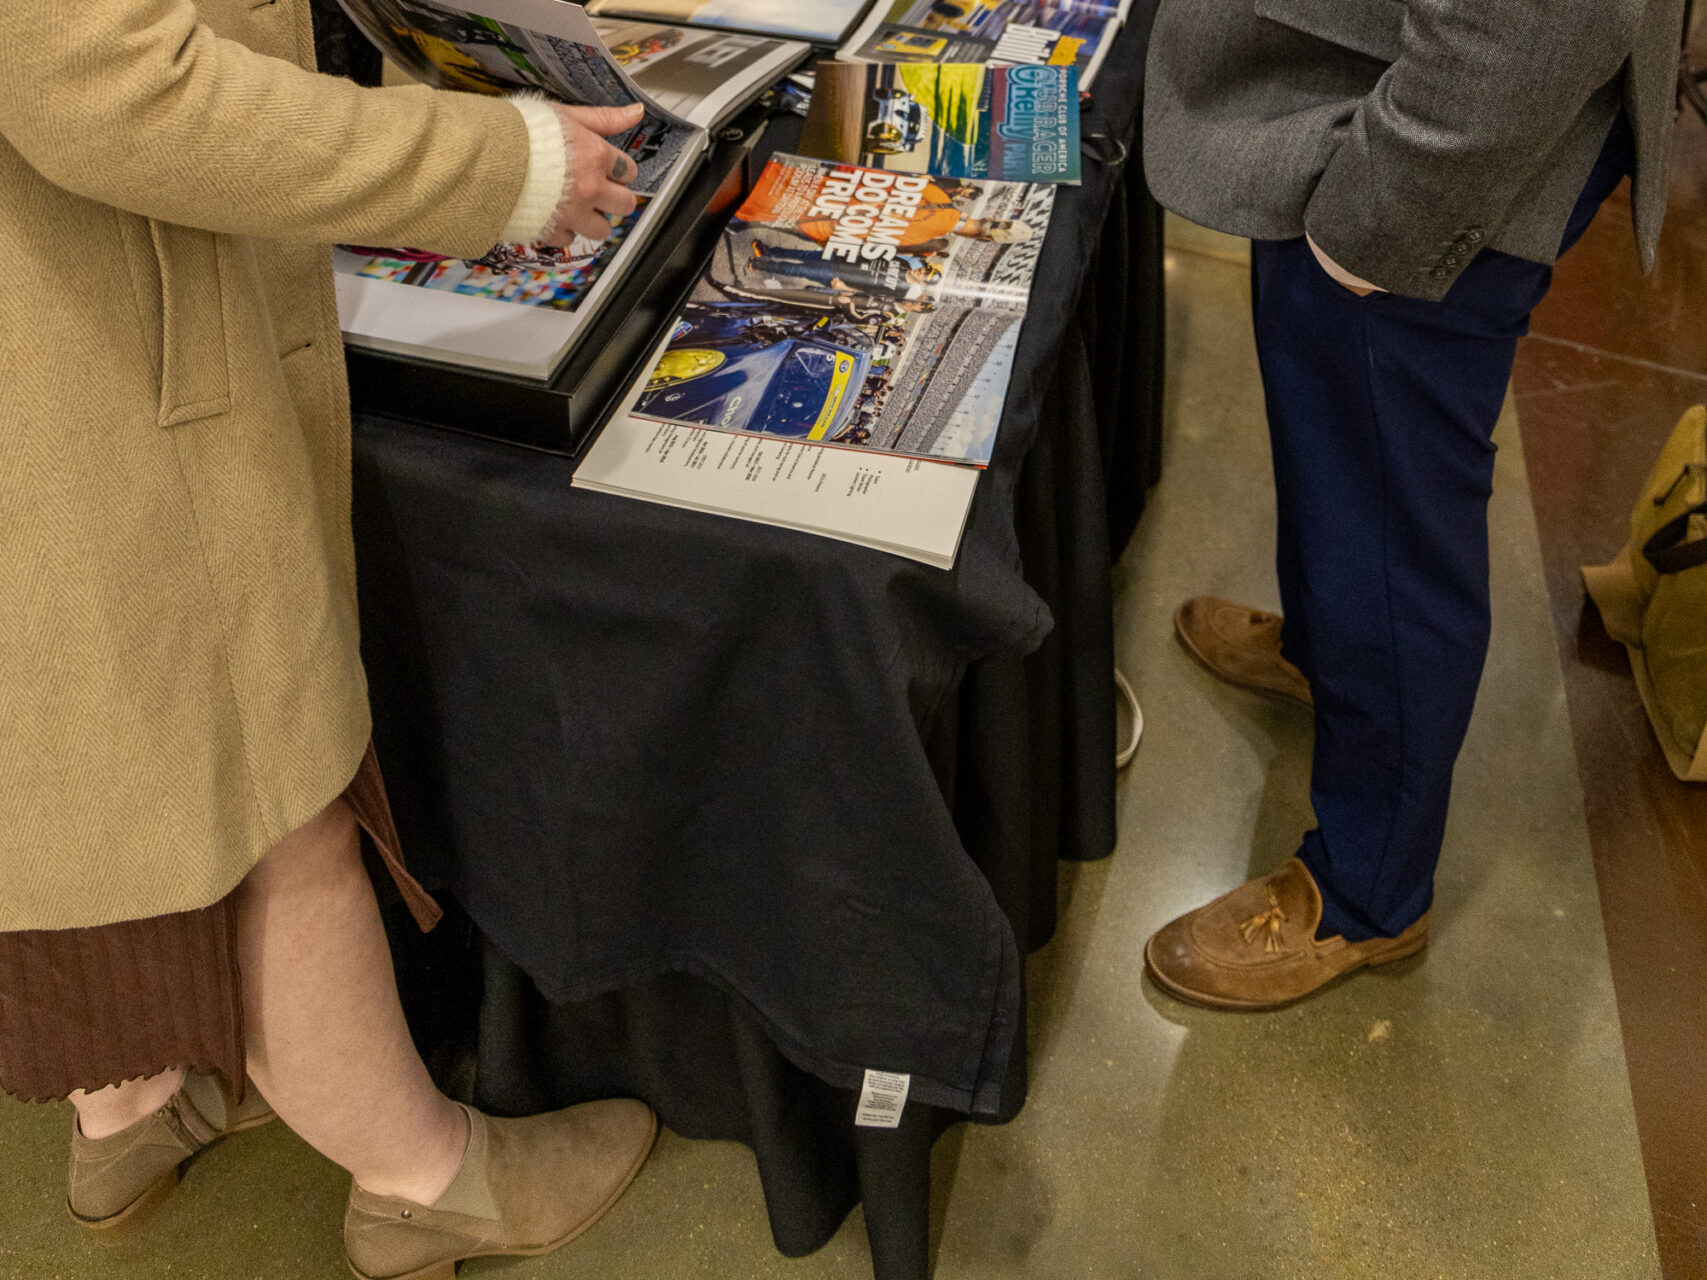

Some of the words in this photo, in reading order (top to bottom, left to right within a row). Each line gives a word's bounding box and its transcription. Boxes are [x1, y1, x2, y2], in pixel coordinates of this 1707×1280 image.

[1033, 67, 1058, 113] CLUB
[1058, 68, 1067, 102] PORSCHE
[1058, 105, 1067, 124] CLUB
[1058, 127, 1067, 136] OF
[1032, 117, 1057, 174] RACER
[1058, 139, 1067, 173] AMERICA
[807, 170, 863, 219] TRUE
[855, 172, 895, 202] DO
[821, 205, 879, 263] COME
[861, 176, 928, 261] DREAMS
[720, 396, 742, 427] Cho
